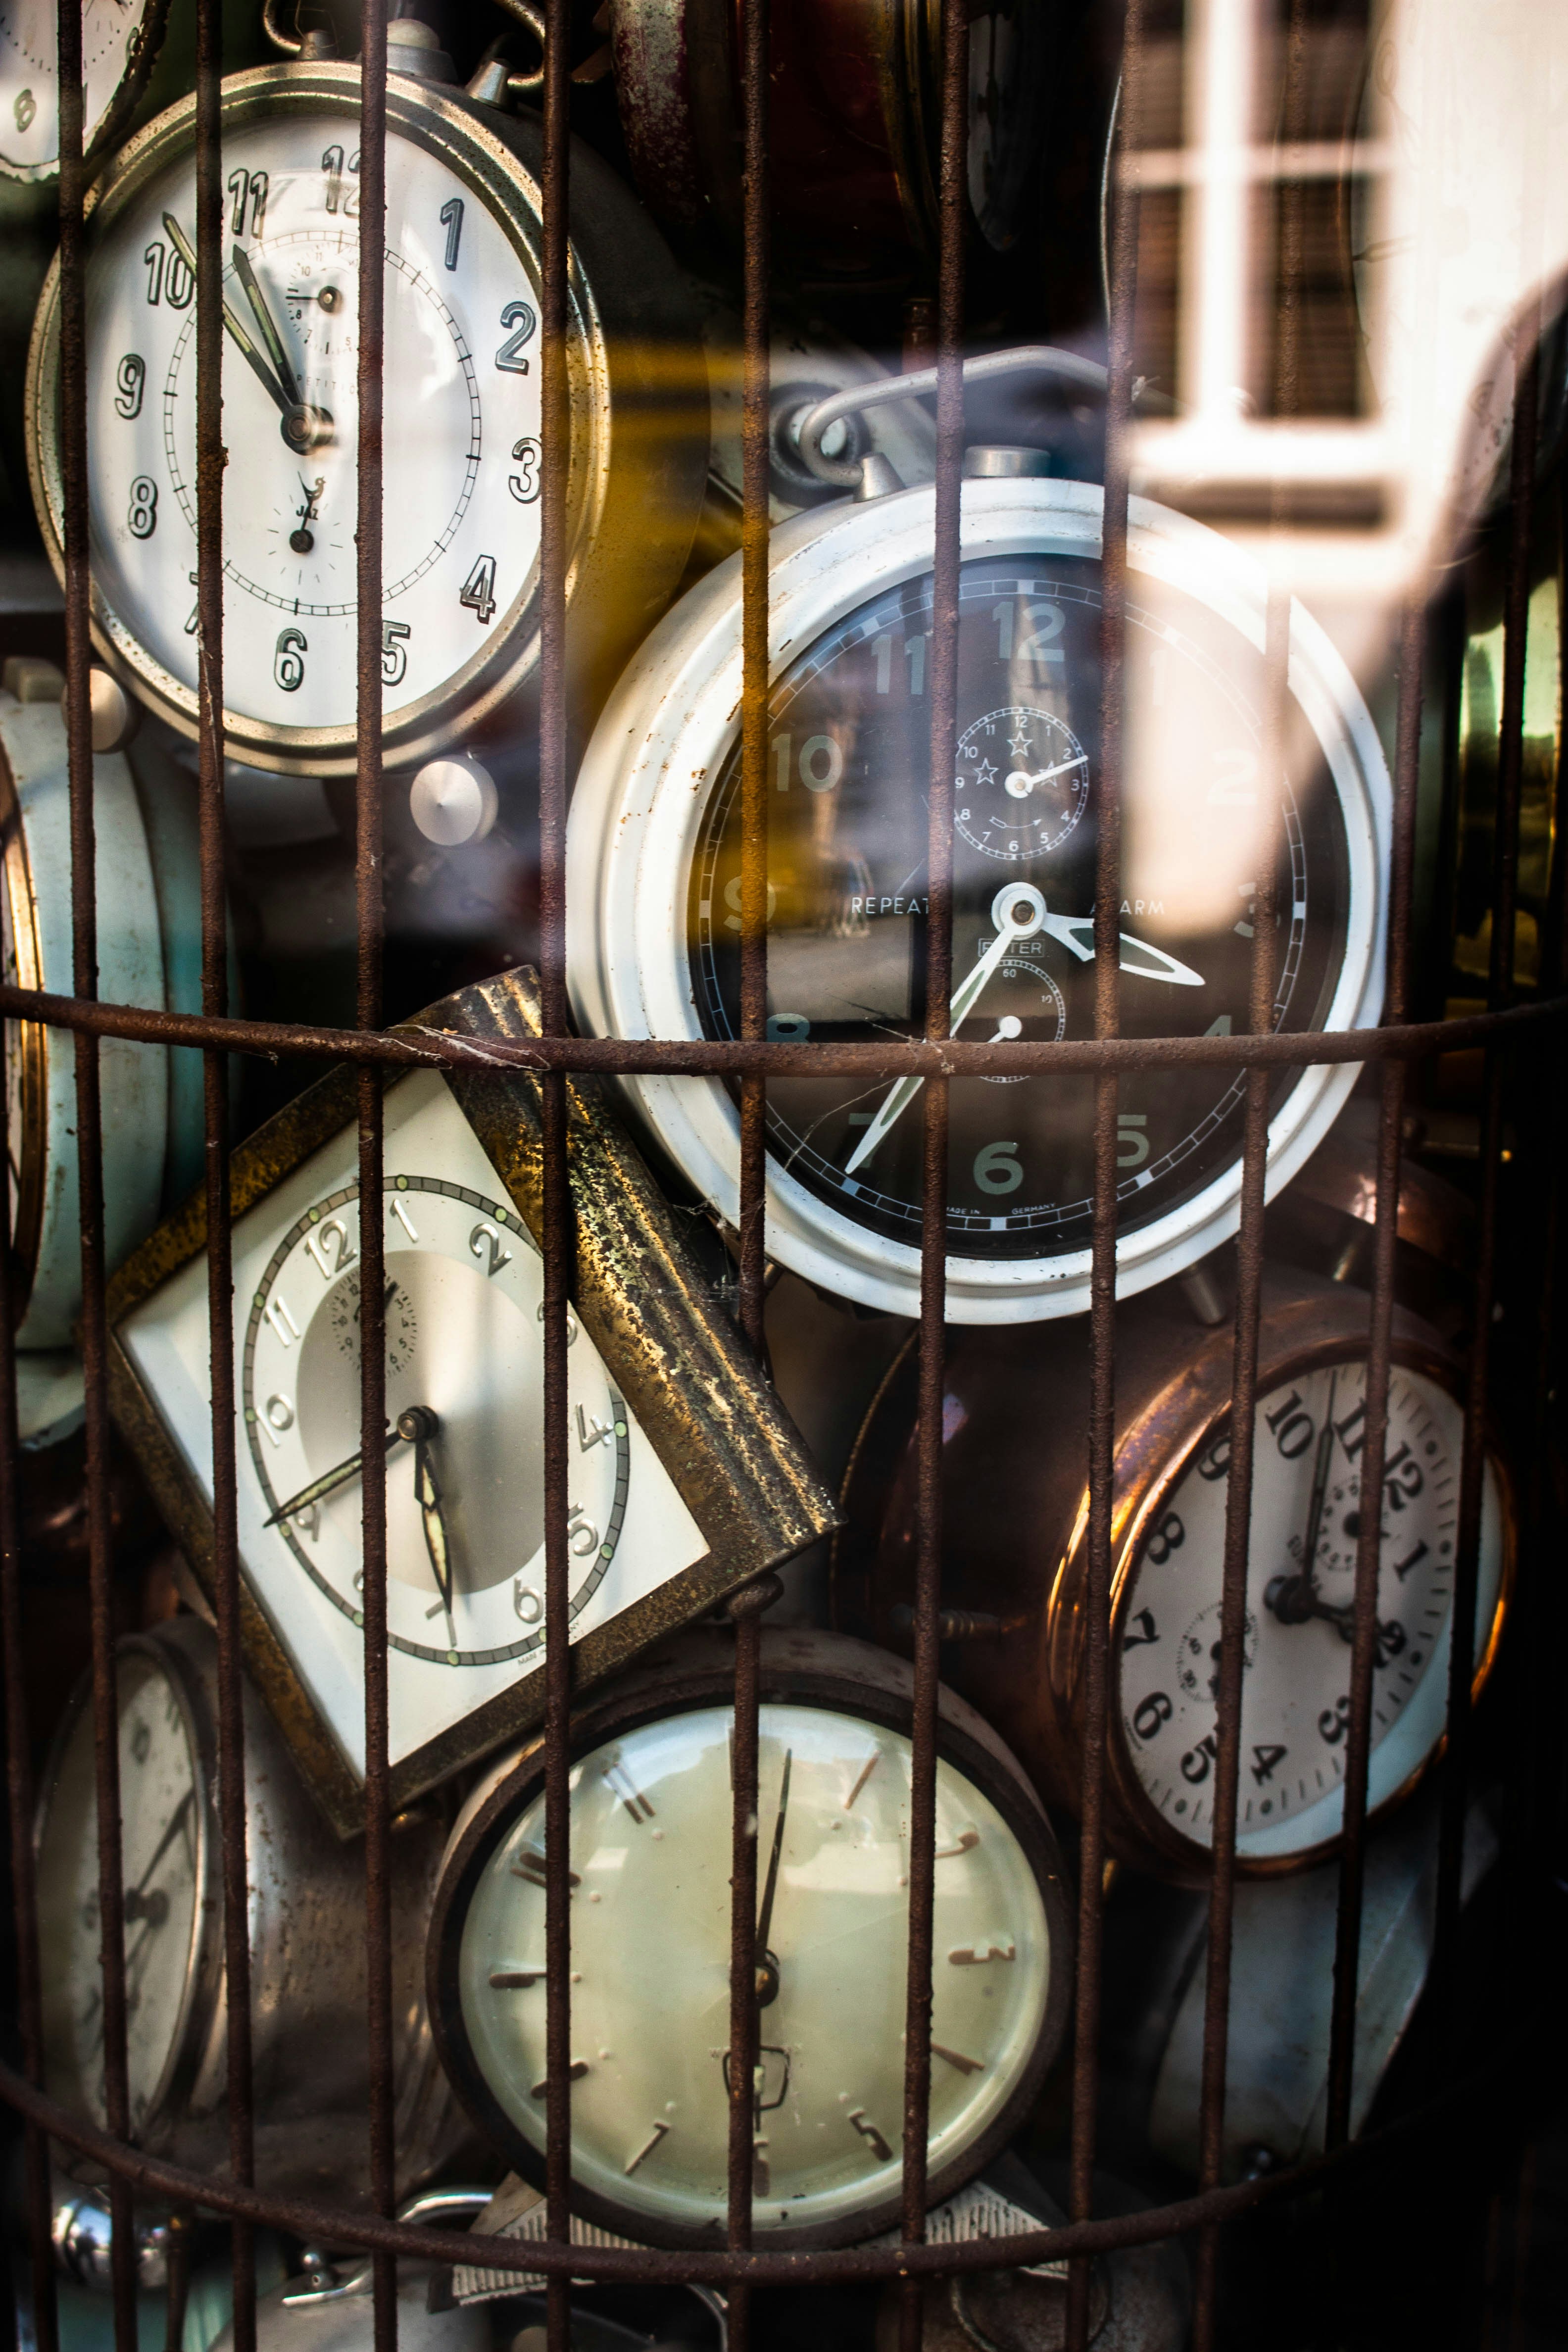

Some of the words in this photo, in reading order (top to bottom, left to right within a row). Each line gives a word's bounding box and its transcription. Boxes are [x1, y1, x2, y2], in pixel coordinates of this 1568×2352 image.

[228, 168, 269, 239] 11
[440, 197, 464, 271] 1
[145, 242, 197, 309] 10
[301, 266, 311, 276] 10
[295, 309, 302, 319] 8
[495, 301, 536, 375] 2
[115, 354, 146, 420] 9
[509, 438, 541, 504] 3
[128, 476, 157, 539] 8
[459, 554, 496, 624] 4
[382, 620, 410, 686] 5
[992, 601, 1066, 662] 12
[274, 628, 308, 692] 6
[871, 635, 926, 695] 11
[985, 725, 995, 735] 11
[1015, 716, 1028, 728] 12
[1045, 725, 1051, 736] 1
[771, 733, 842, 792] 10
[963, 746, 978, 758] 10
[1062, 748, 1072, 760] 2
[955, 777, 965, 788] 9
[1071, 779, 1080, 791] 3
[1206, 749, 1259, 806] 2
[960, 808, 971, 820] 8
[982, 831, 992, 842] 7
[1040, 832, 1049, 843] 5
[1060, 810, 1071, 822] 4
[1008, 840, 1019, 852] 6
[851, 897, 929, 915] REPEAT
[981, 942, 1042, 954] PTER
[1003, 969, 1017, 978] 60
[1117, 1115, 1150, 1167] 5
[973, 1141, 1024, 1195] 6
[389, 1198, 420, 1242] 1
[1012, 1203, 1056, 1215] GERMANY
[303, 1219, 358, 1279] 12
[468, 1223, 513, 1276] 2
[264, 1295, 301, 1348] 11
[345, 1337, 353, 1349] 9
[399, 1337, 407, 1349] 5
[401, 1317, 409, 1327] 4
[390, 1353, 397, 1364] 6
[255, 1393, 294, 1448] 10
[575, 1402, 615, 1453] 4
[1265, 1390, 1314, 1459] 10
[1332, 1397, 1366, 1464] 11
[1197, 1436, 1231, 1481] 9
[1384, 1441, 1424, 1512] 12
[567, 1502, 599, 1556] 5
[1147, 1512, 1185, 1565] 8
[1393, 1539, 1429, 1582] 1
[425, 1602, 458, 1647] 7
[513, 1576, 544, 1624] 6
[1122, 1607, 1161, 1652] 7
[1132, 1691, 1173, 1741] 6
[1318, 1695, 1353, 1745] 3
[1180, 1732, 1217, 1784] 5
[1251, 1744, 1288, 1783] 4
